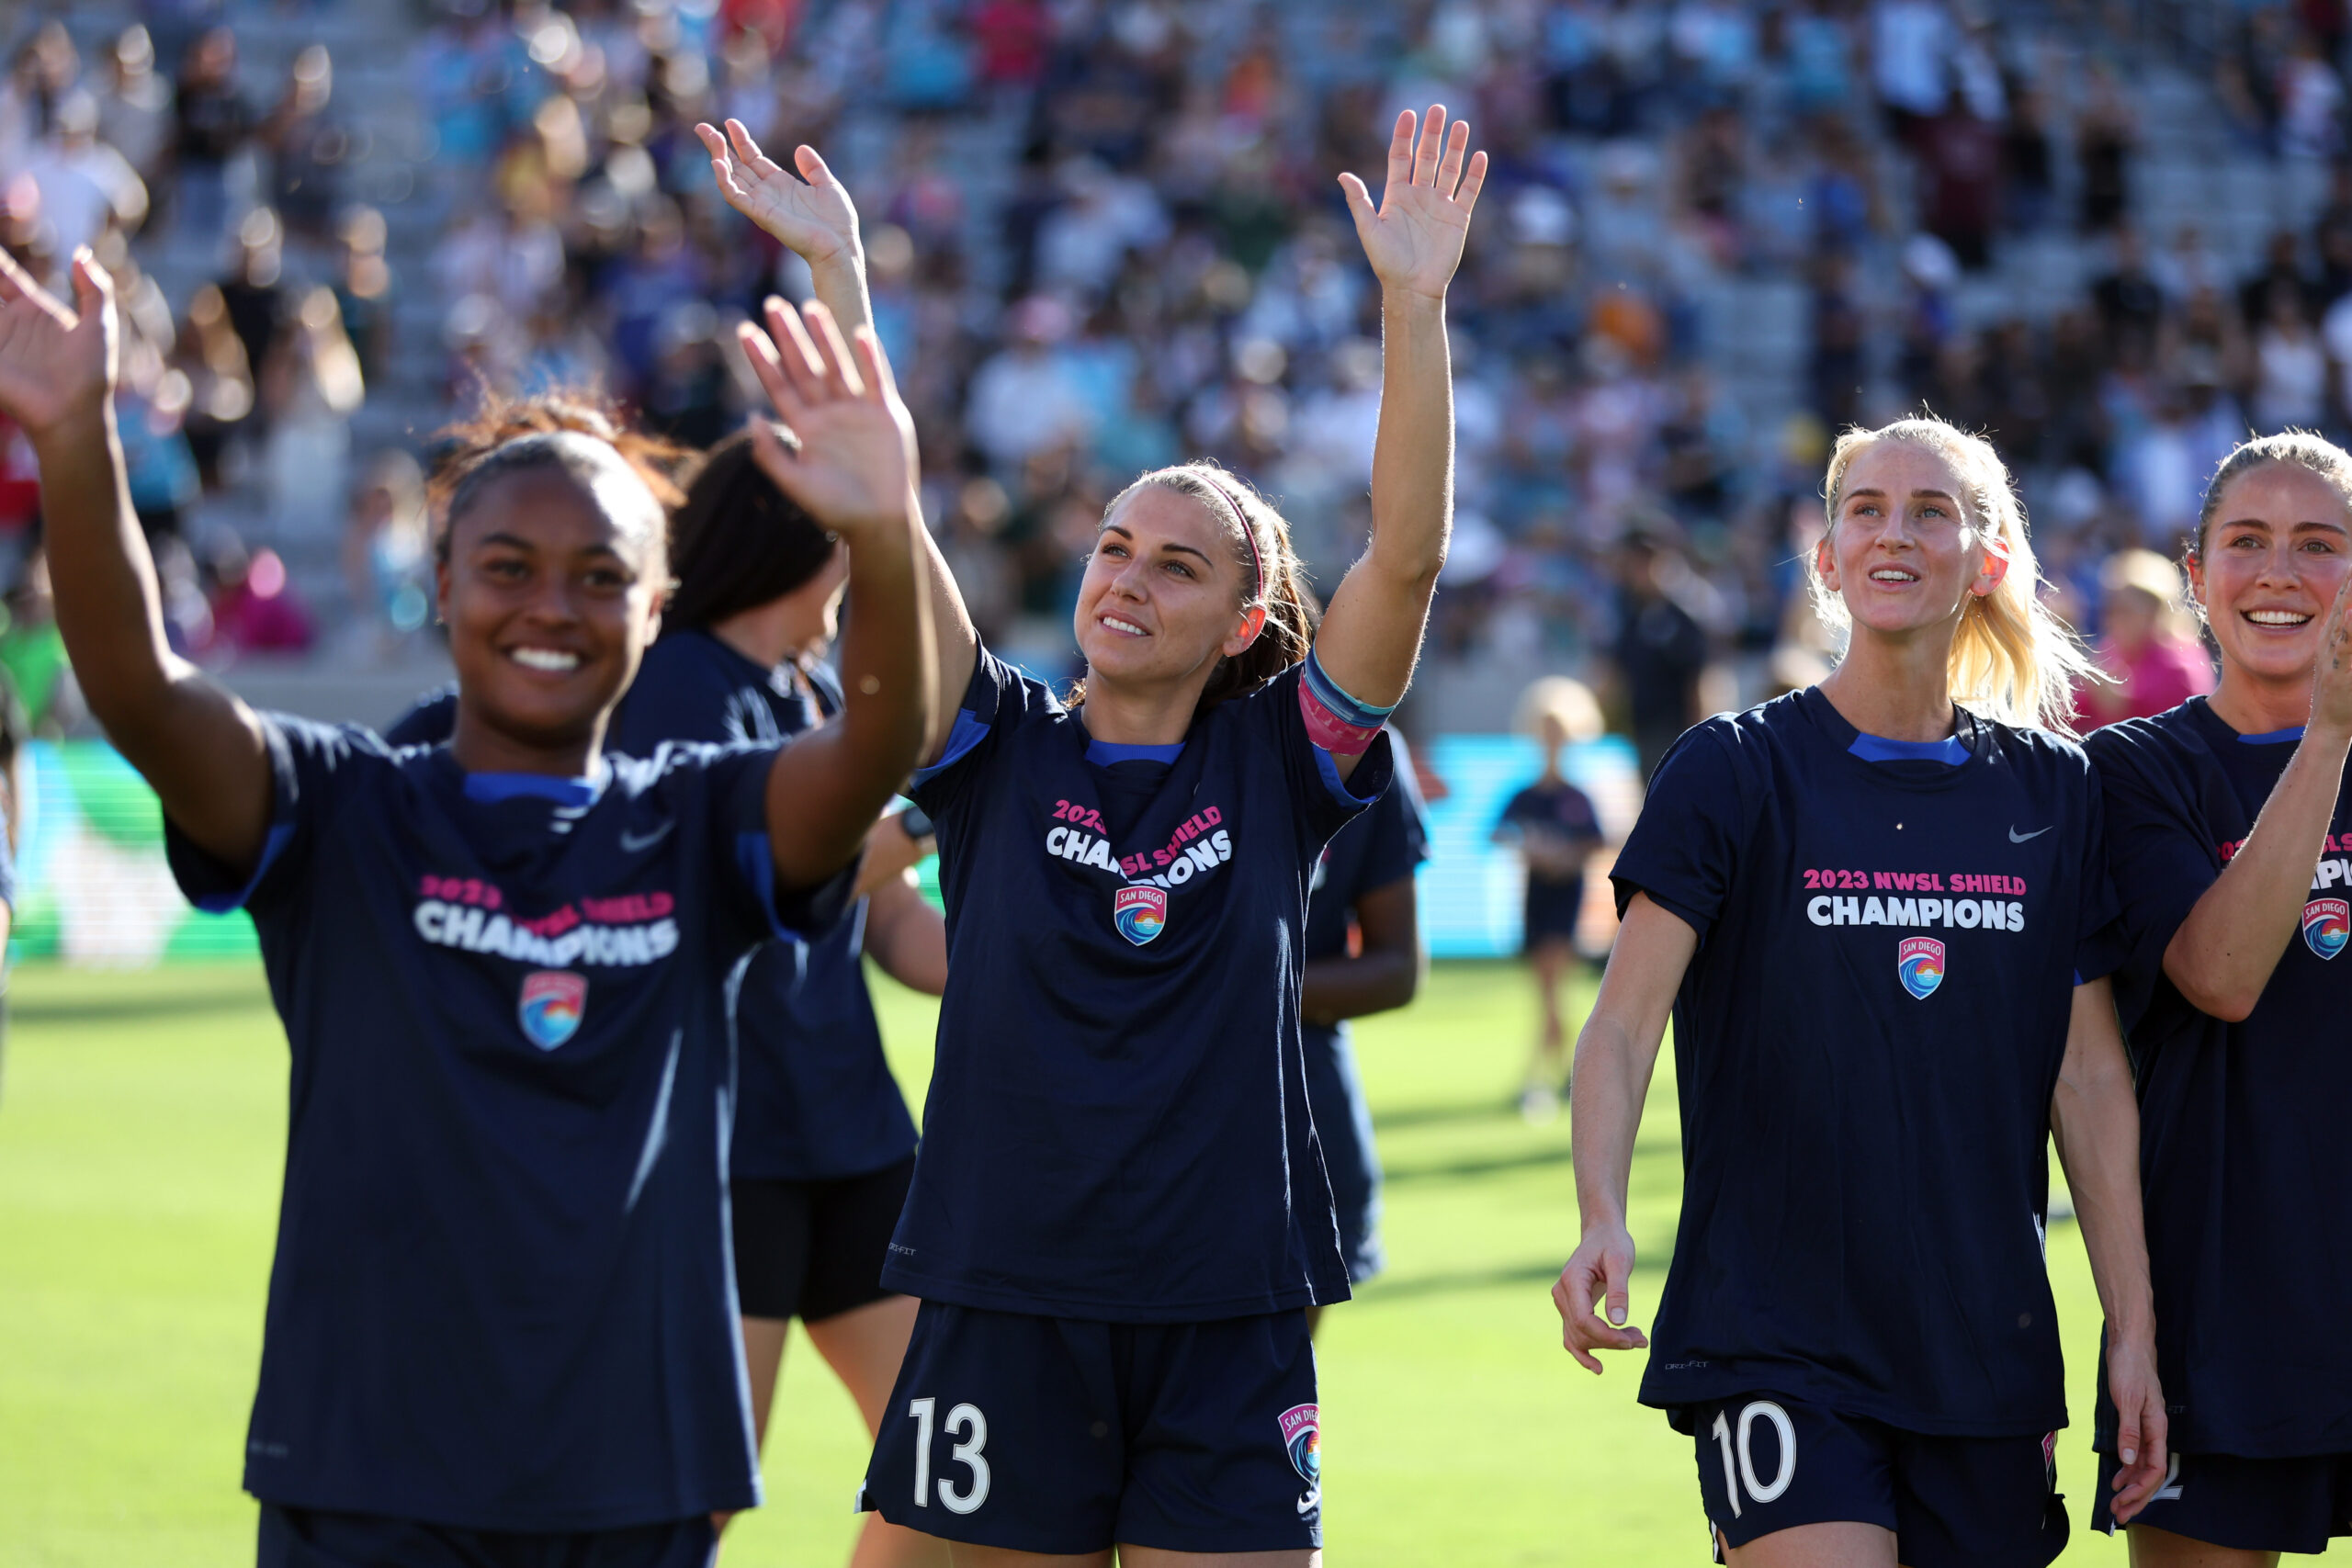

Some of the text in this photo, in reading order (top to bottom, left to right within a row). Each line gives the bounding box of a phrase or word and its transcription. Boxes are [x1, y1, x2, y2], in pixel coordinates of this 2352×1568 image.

[1120, 852, 1153, 876] SL
[1153, 806, 1222, 865] SHIELD
[1119, 891, 1162, 905] SAN DIEGO
[1803, 869, 2027, 896] 2023 NWSL SHIELD
[1806, 896, 2025, 932] CHAMPIONS
[2305, 903, 2345, 919] SAN DIEGO
[413, 899, 680, 968] CHAMPIONS
[1903, 942, 1940, 955] SAN DIEGO
[1284, 1409, 1318, 1432] SAN DIE
[909, 1397, 990, 1515] 13
[1713, 1401, 1796, 1519] 10
